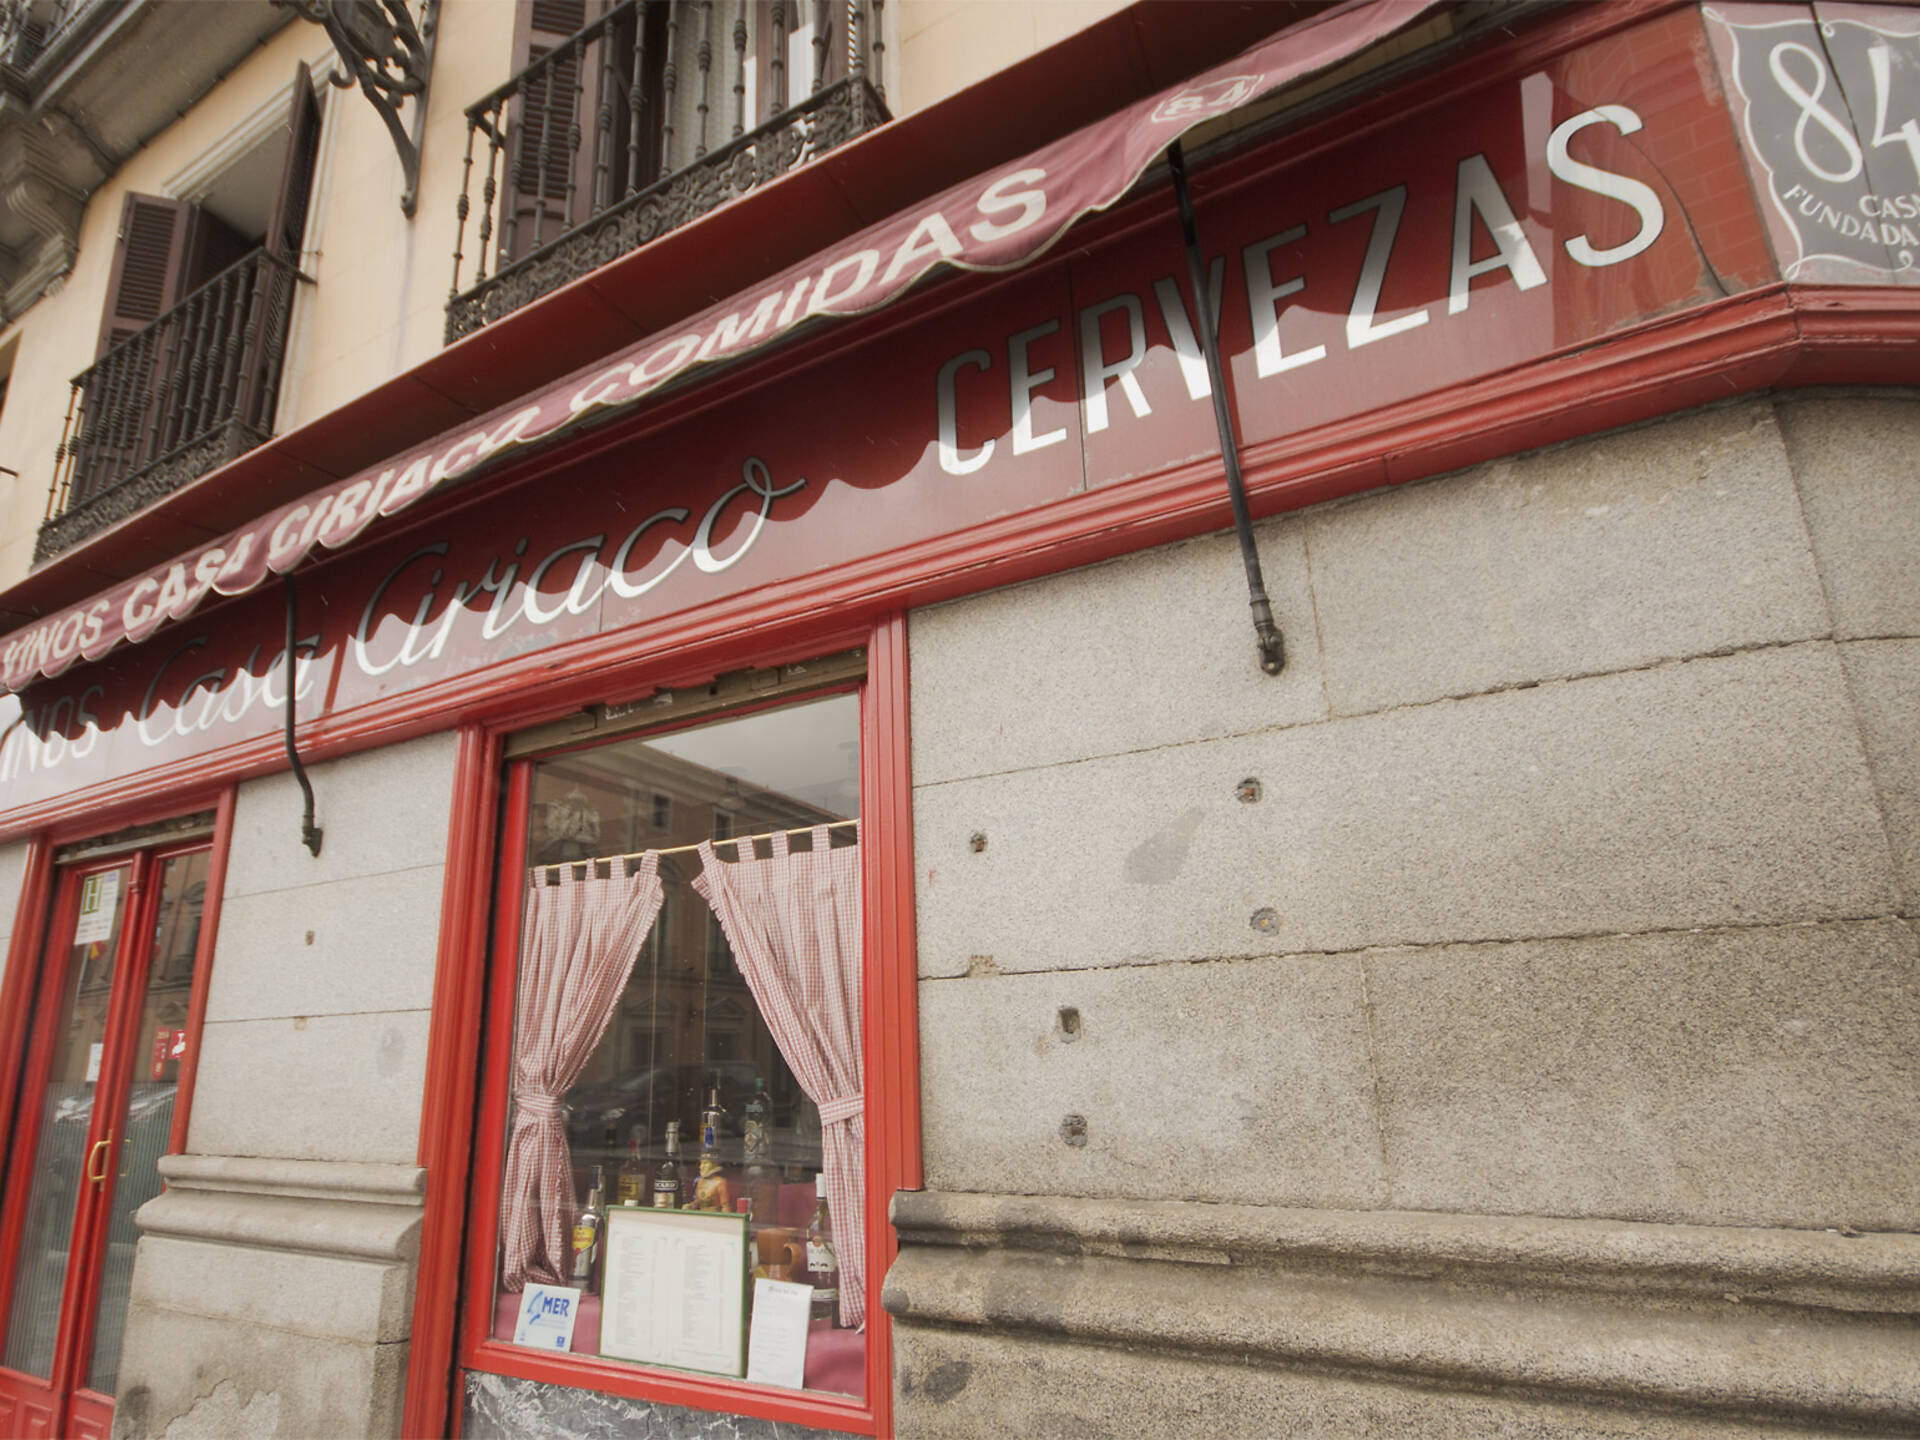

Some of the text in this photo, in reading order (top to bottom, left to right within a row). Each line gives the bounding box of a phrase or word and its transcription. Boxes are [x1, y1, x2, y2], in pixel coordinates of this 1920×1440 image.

[1769, 42, 1920, 190] 84
[1782, 184, 1920, 247] FUNDADA
[2, 167, 1048, 680] VINOS CASA CIRIACO COMIDAS
[137, 633, 321, 748] Casa
[354, 457, 808, 677] Ciriaco
[935, 104, 1665, 476] CERVEZAS
